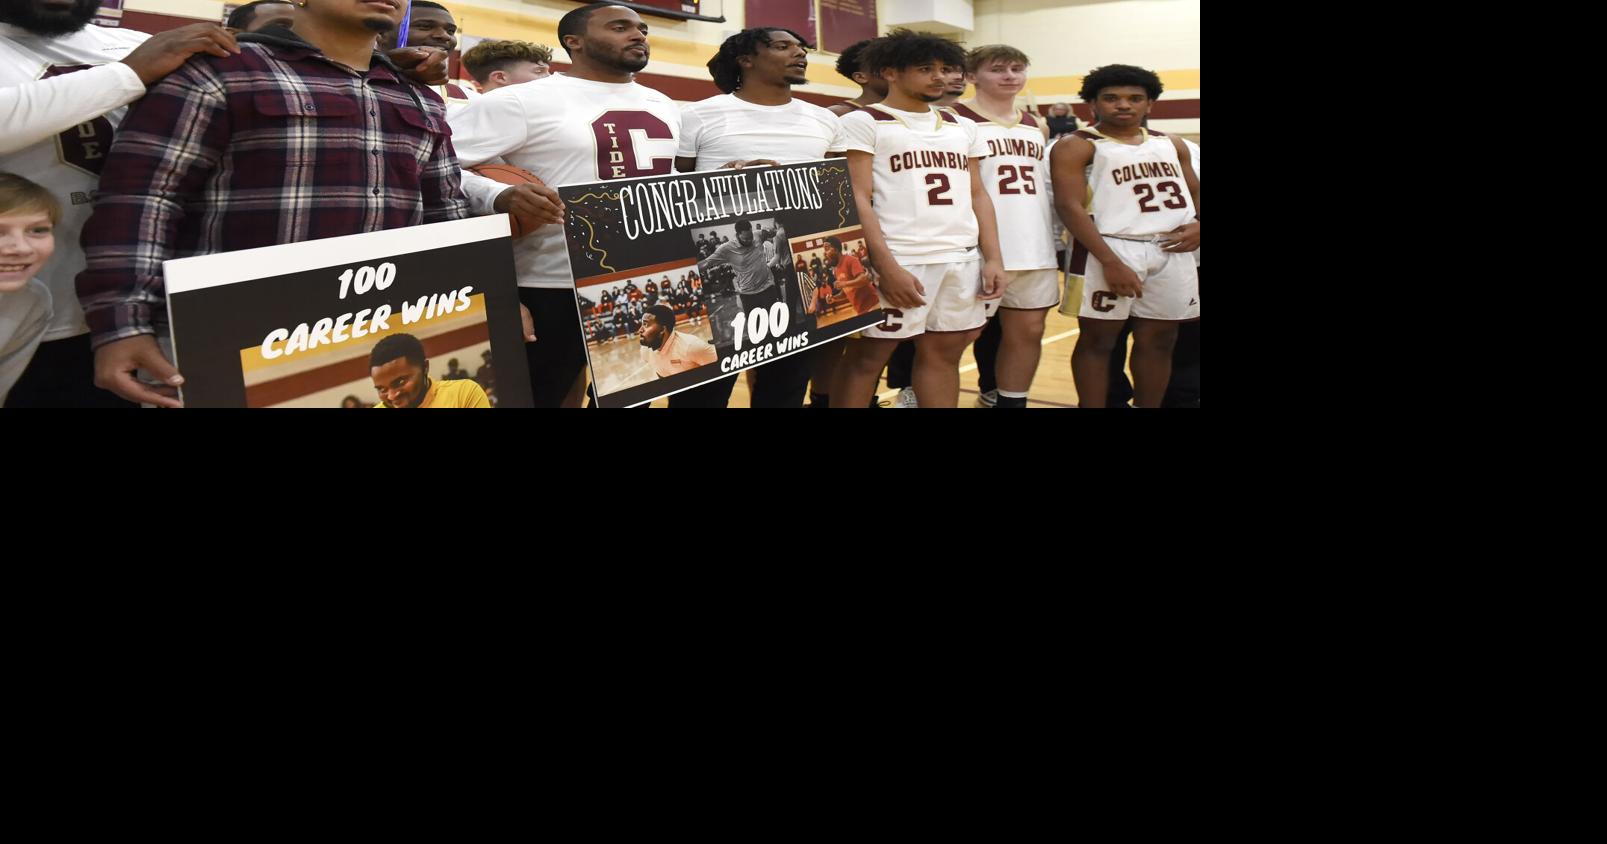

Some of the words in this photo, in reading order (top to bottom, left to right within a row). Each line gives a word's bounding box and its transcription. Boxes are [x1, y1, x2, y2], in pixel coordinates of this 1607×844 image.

[603, 123, 626, 178] TIDE
[924, 173, 953, 206] 2
[997, 165, 1037, 195] 25
[1111, 162, 1181, 185] COLUMBI
[619, 166, 823, 241] CONGRATULATIONS
[1132, 180, 1187, 213] 23
[338, 262, 397, 300] 100
[261, 304, 392, 360] CAREER
[401, 285, 473, 325] WINS
[730, 301, 790, 351] 100
[720, 342, 773, 373] CAREER
[776, 331, 809, 354] WINS
